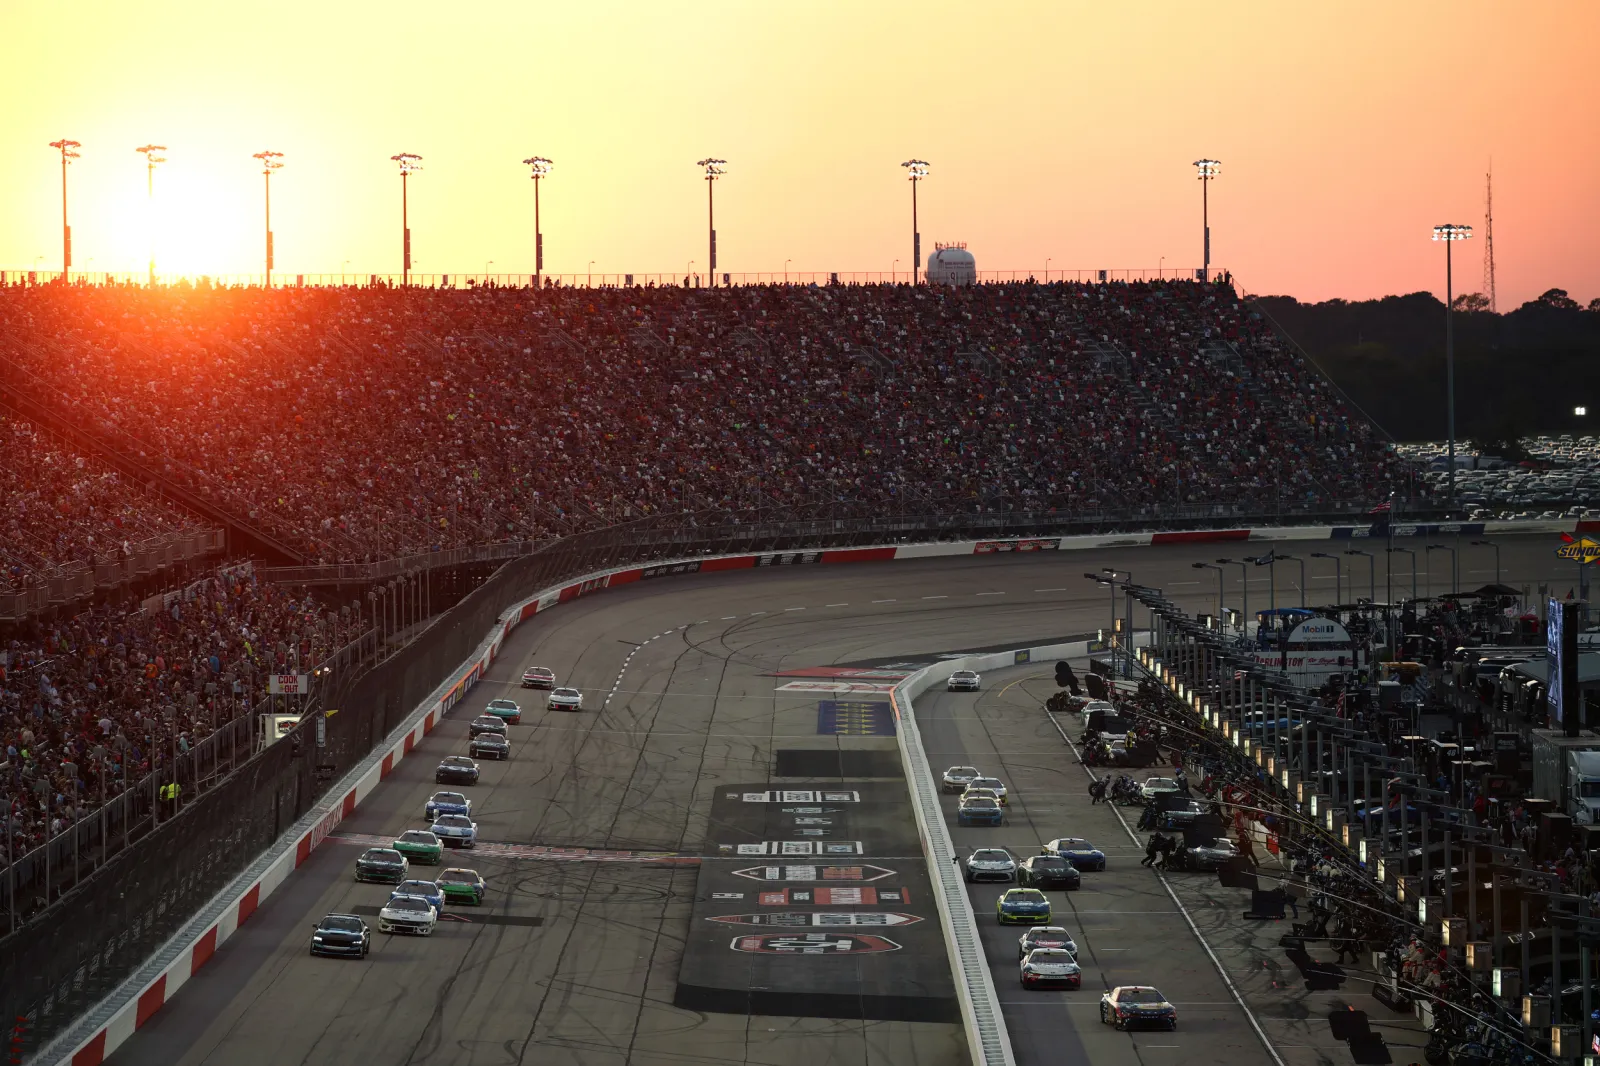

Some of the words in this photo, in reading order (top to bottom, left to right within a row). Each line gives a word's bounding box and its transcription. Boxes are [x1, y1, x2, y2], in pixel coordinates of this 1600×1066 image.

[1302, 625, 1325, 633] Mobil
[1326, 625, 1334, 633] 1
[1254, 655, 1304, 667] DARLINTON
[278, 675, 298, 683] COOK
[284, 685, 298, 693] OUT
